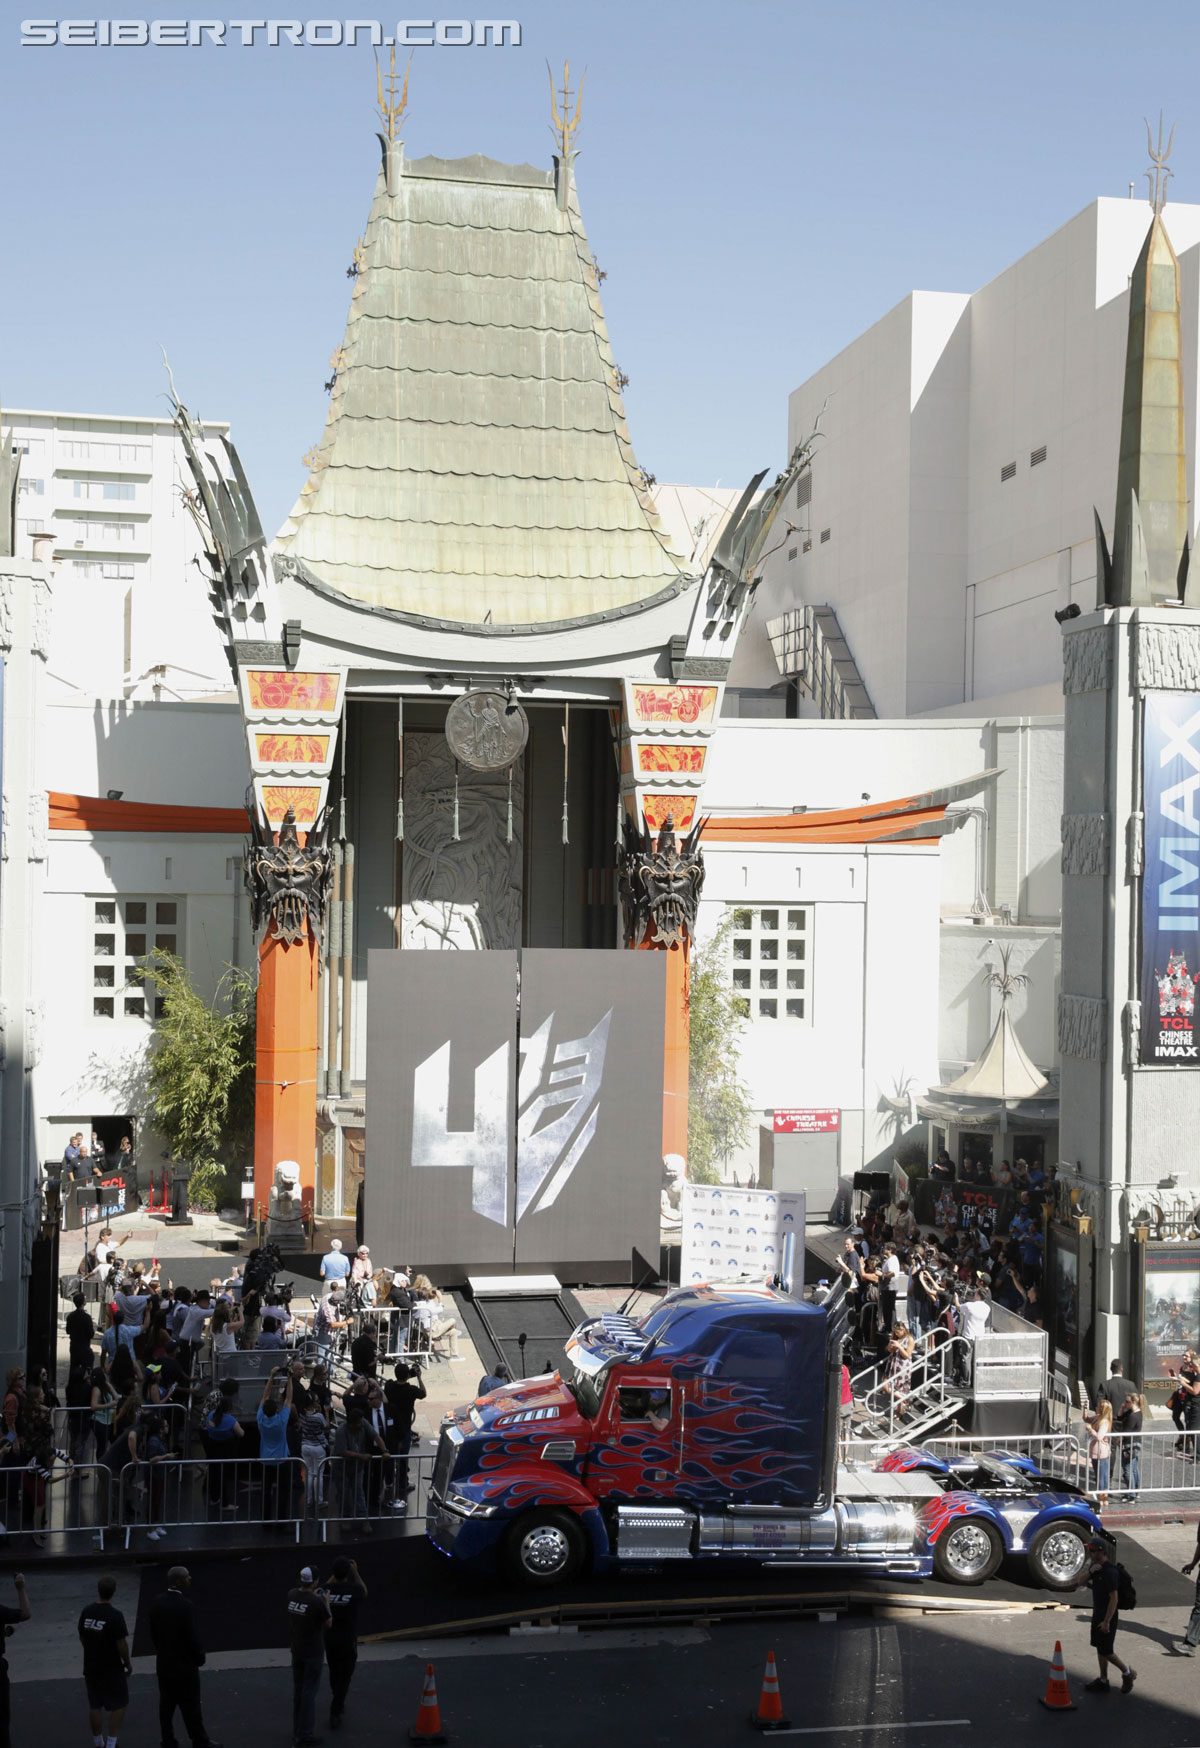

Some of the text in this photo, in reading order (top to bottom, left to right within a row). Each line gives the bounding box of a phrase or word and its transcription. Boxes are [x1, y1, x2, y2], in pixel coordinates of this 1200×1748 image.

[1158, 708, 1200, 931] IMAX
[1160, 1017, 1193, 1030] TCL
[1159, 1030, 1193, 1039] CHINESE
[1160, 1037, 1193, 1046] THEATRE
[1155, 1046, 1199, 1057] IMAX
[101, 1176, 126, 1189] TCL
[962, 1191, 999, 1208] TCL
[287, 1600, 308, 1613] ELS
[84, 1618, 106, 1631] ELS
